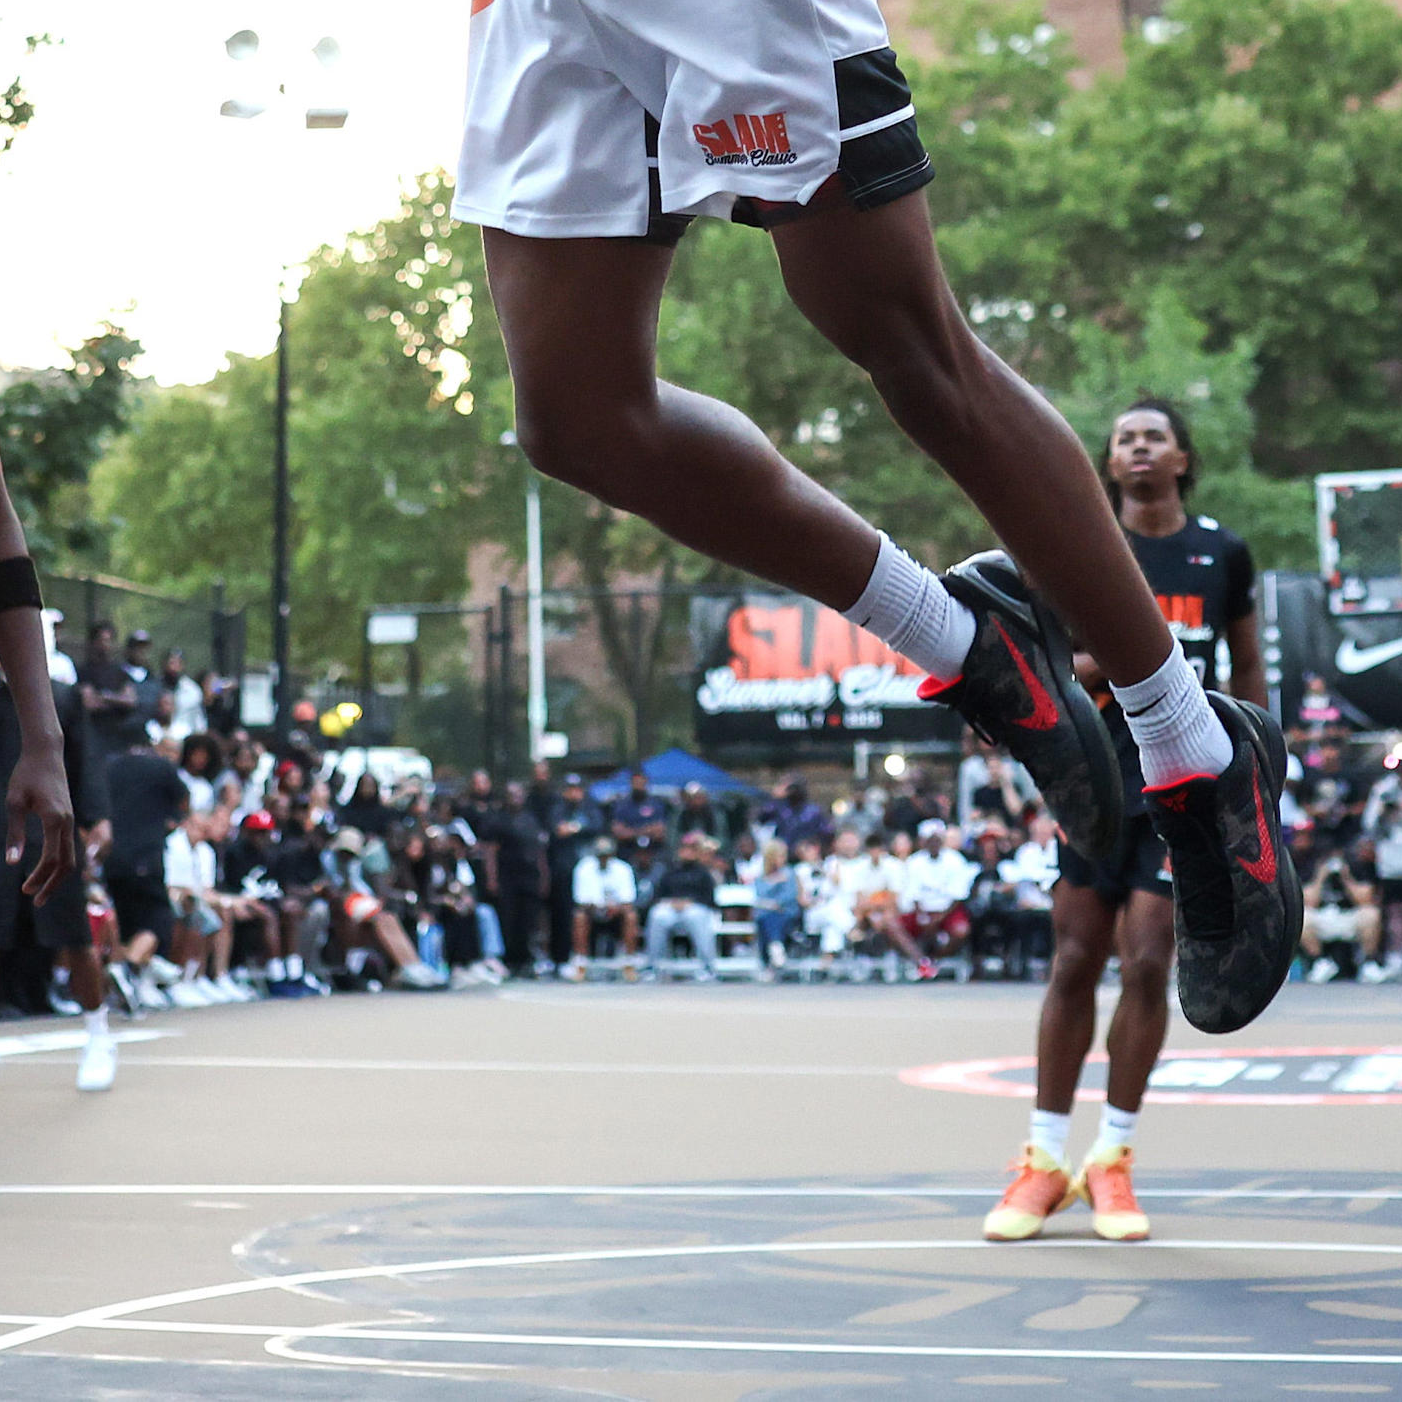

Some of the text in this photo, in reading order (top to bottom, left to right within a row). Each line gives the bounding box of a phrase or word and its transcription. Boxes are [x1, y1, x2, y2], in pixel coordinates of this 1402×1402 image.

[693, 112, 791, 157] SLAM
[750, 149, 798, 167] Classic
[697, 663, 928, 715] Summer Clas
